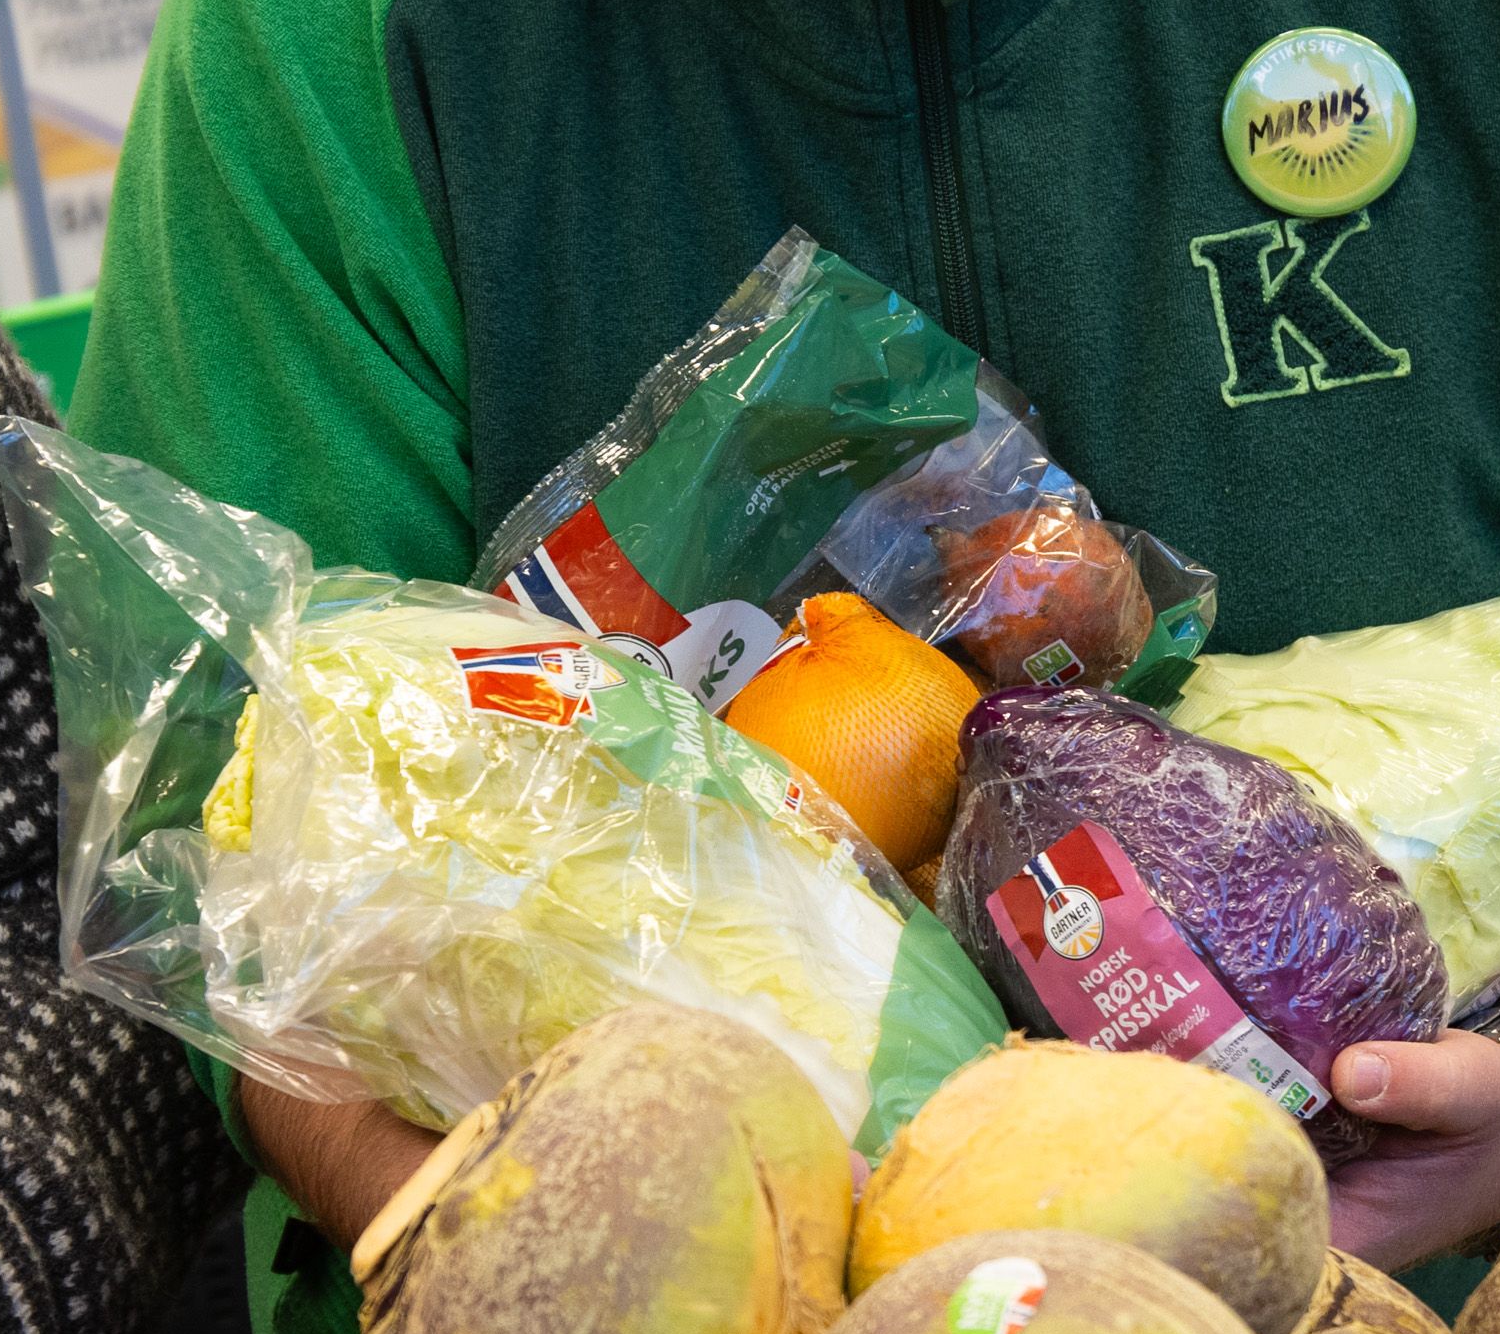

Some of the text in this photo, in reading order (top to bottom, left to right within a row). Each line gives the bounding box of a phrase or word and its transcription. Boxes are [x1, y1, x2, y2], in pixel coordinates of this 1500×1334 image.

[1248, 83, 1370, 156] MARIUS
[1190, 208, 1412, 408] K
[745, 438, 850, 516] OPPSKRIFTSTIPS
[771, 448, 844, 494] BAKSIDEN
[1028, 646, 1064, 672] NYT
[1050, 901, 1092, 940] GARTNER
[1078, 946, 1132, 994] NORSK
[1092, 968, 1149, 1019] RØD
[1089, 970, 1201, 1052] SPISSKÅL
[1271, 1068, 1292, 1090] dagen
[1279, 1084, 1302, 1108] NYT
